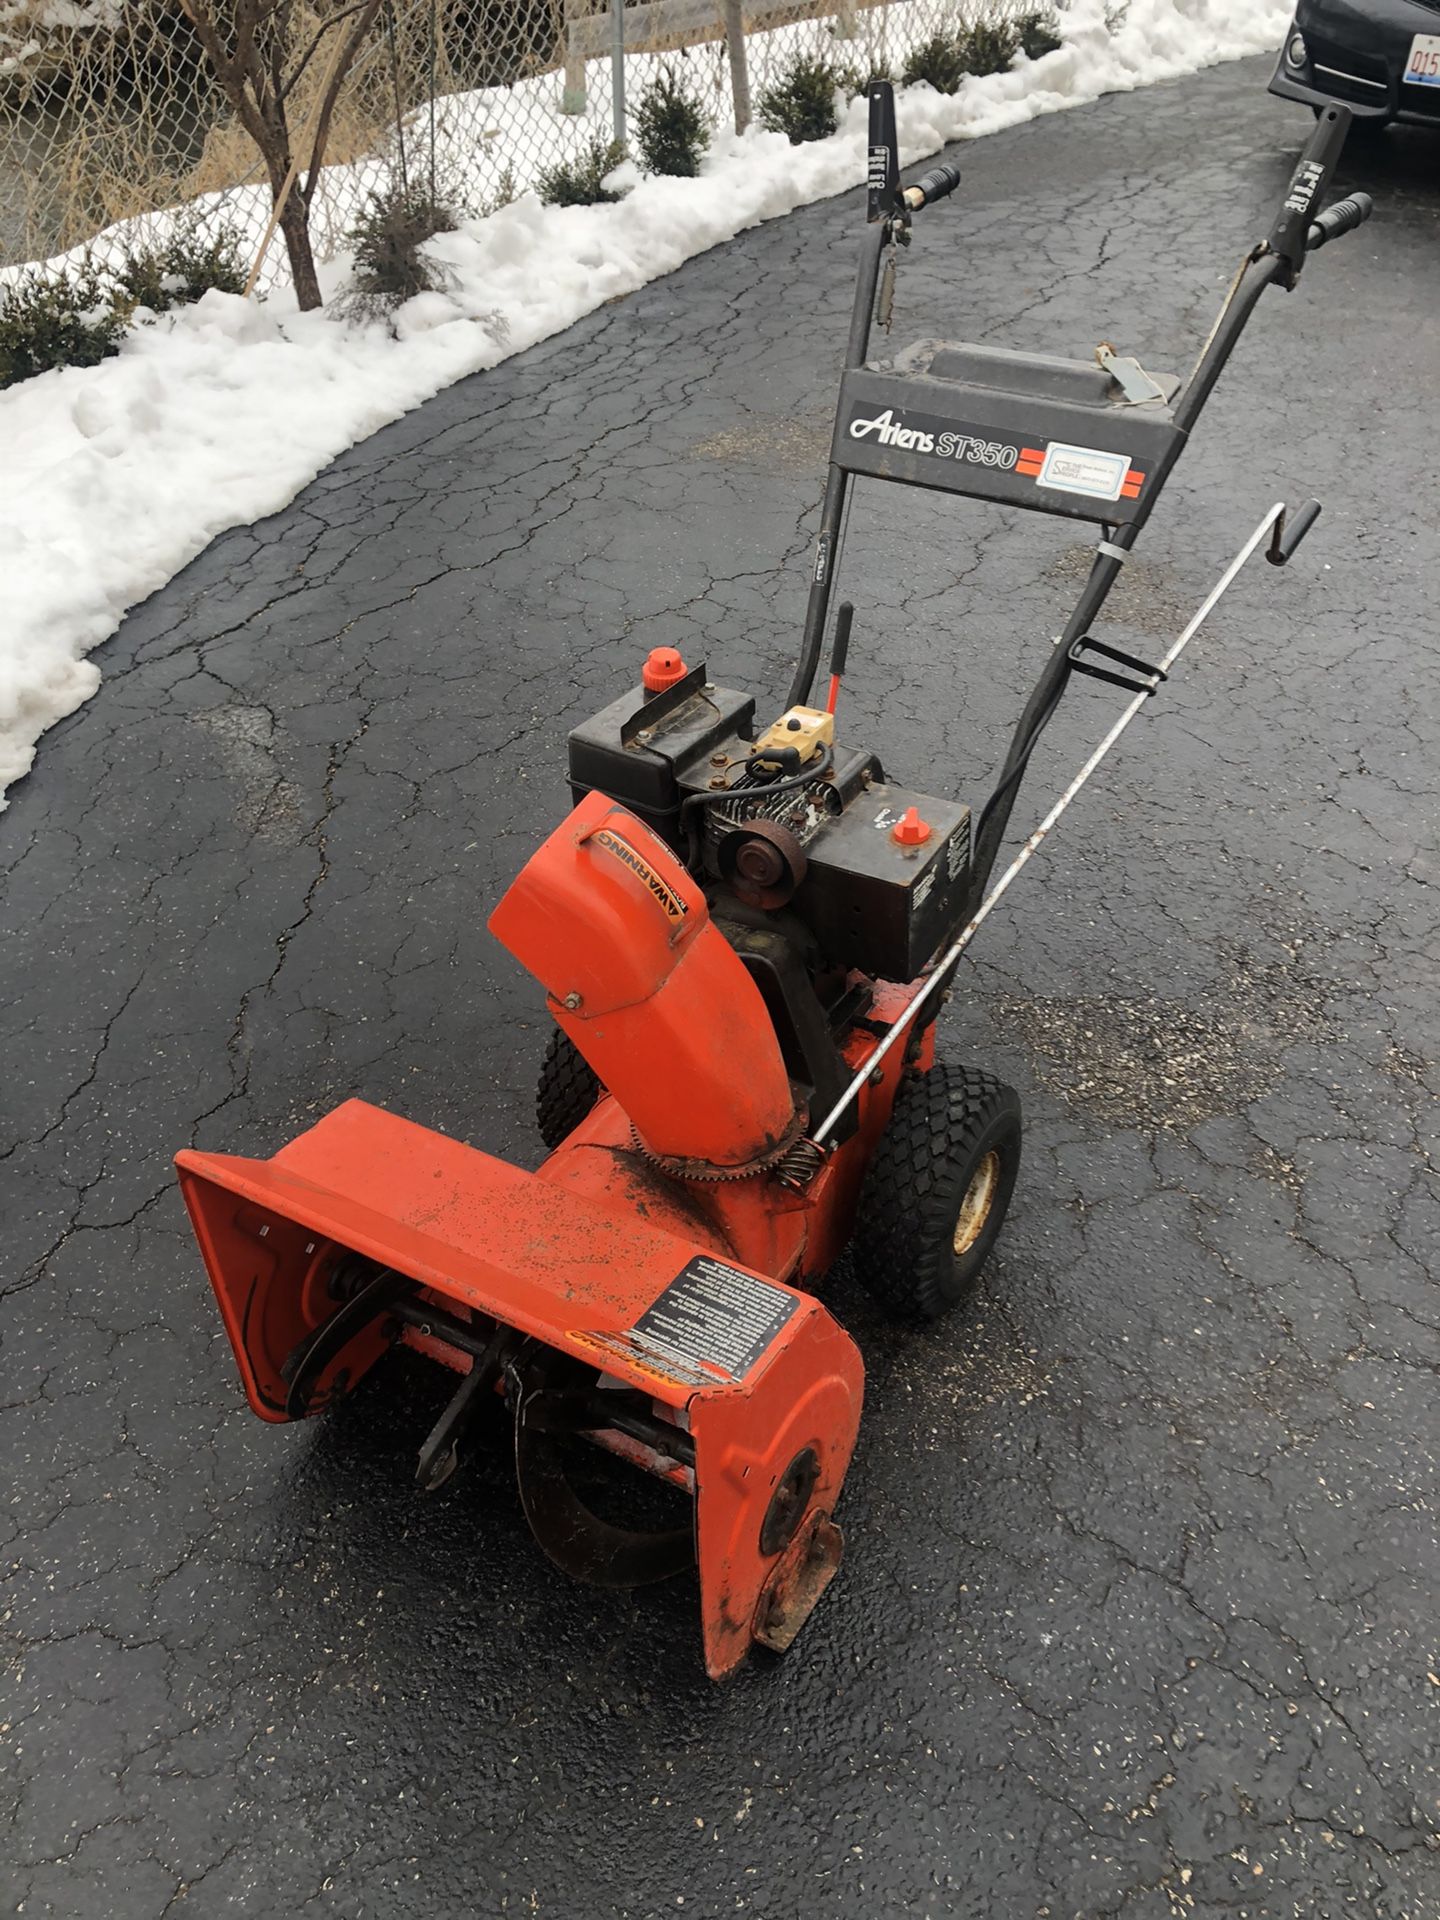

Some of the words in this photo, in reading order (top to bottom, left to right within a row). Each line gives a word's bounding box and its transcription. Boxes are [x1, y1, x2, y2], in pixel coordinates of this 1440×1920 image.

[850, 410, 934, 453] Ariens
[936, 431, 1018, 469] ST350
[598, 831, 671, 907] WARNING
